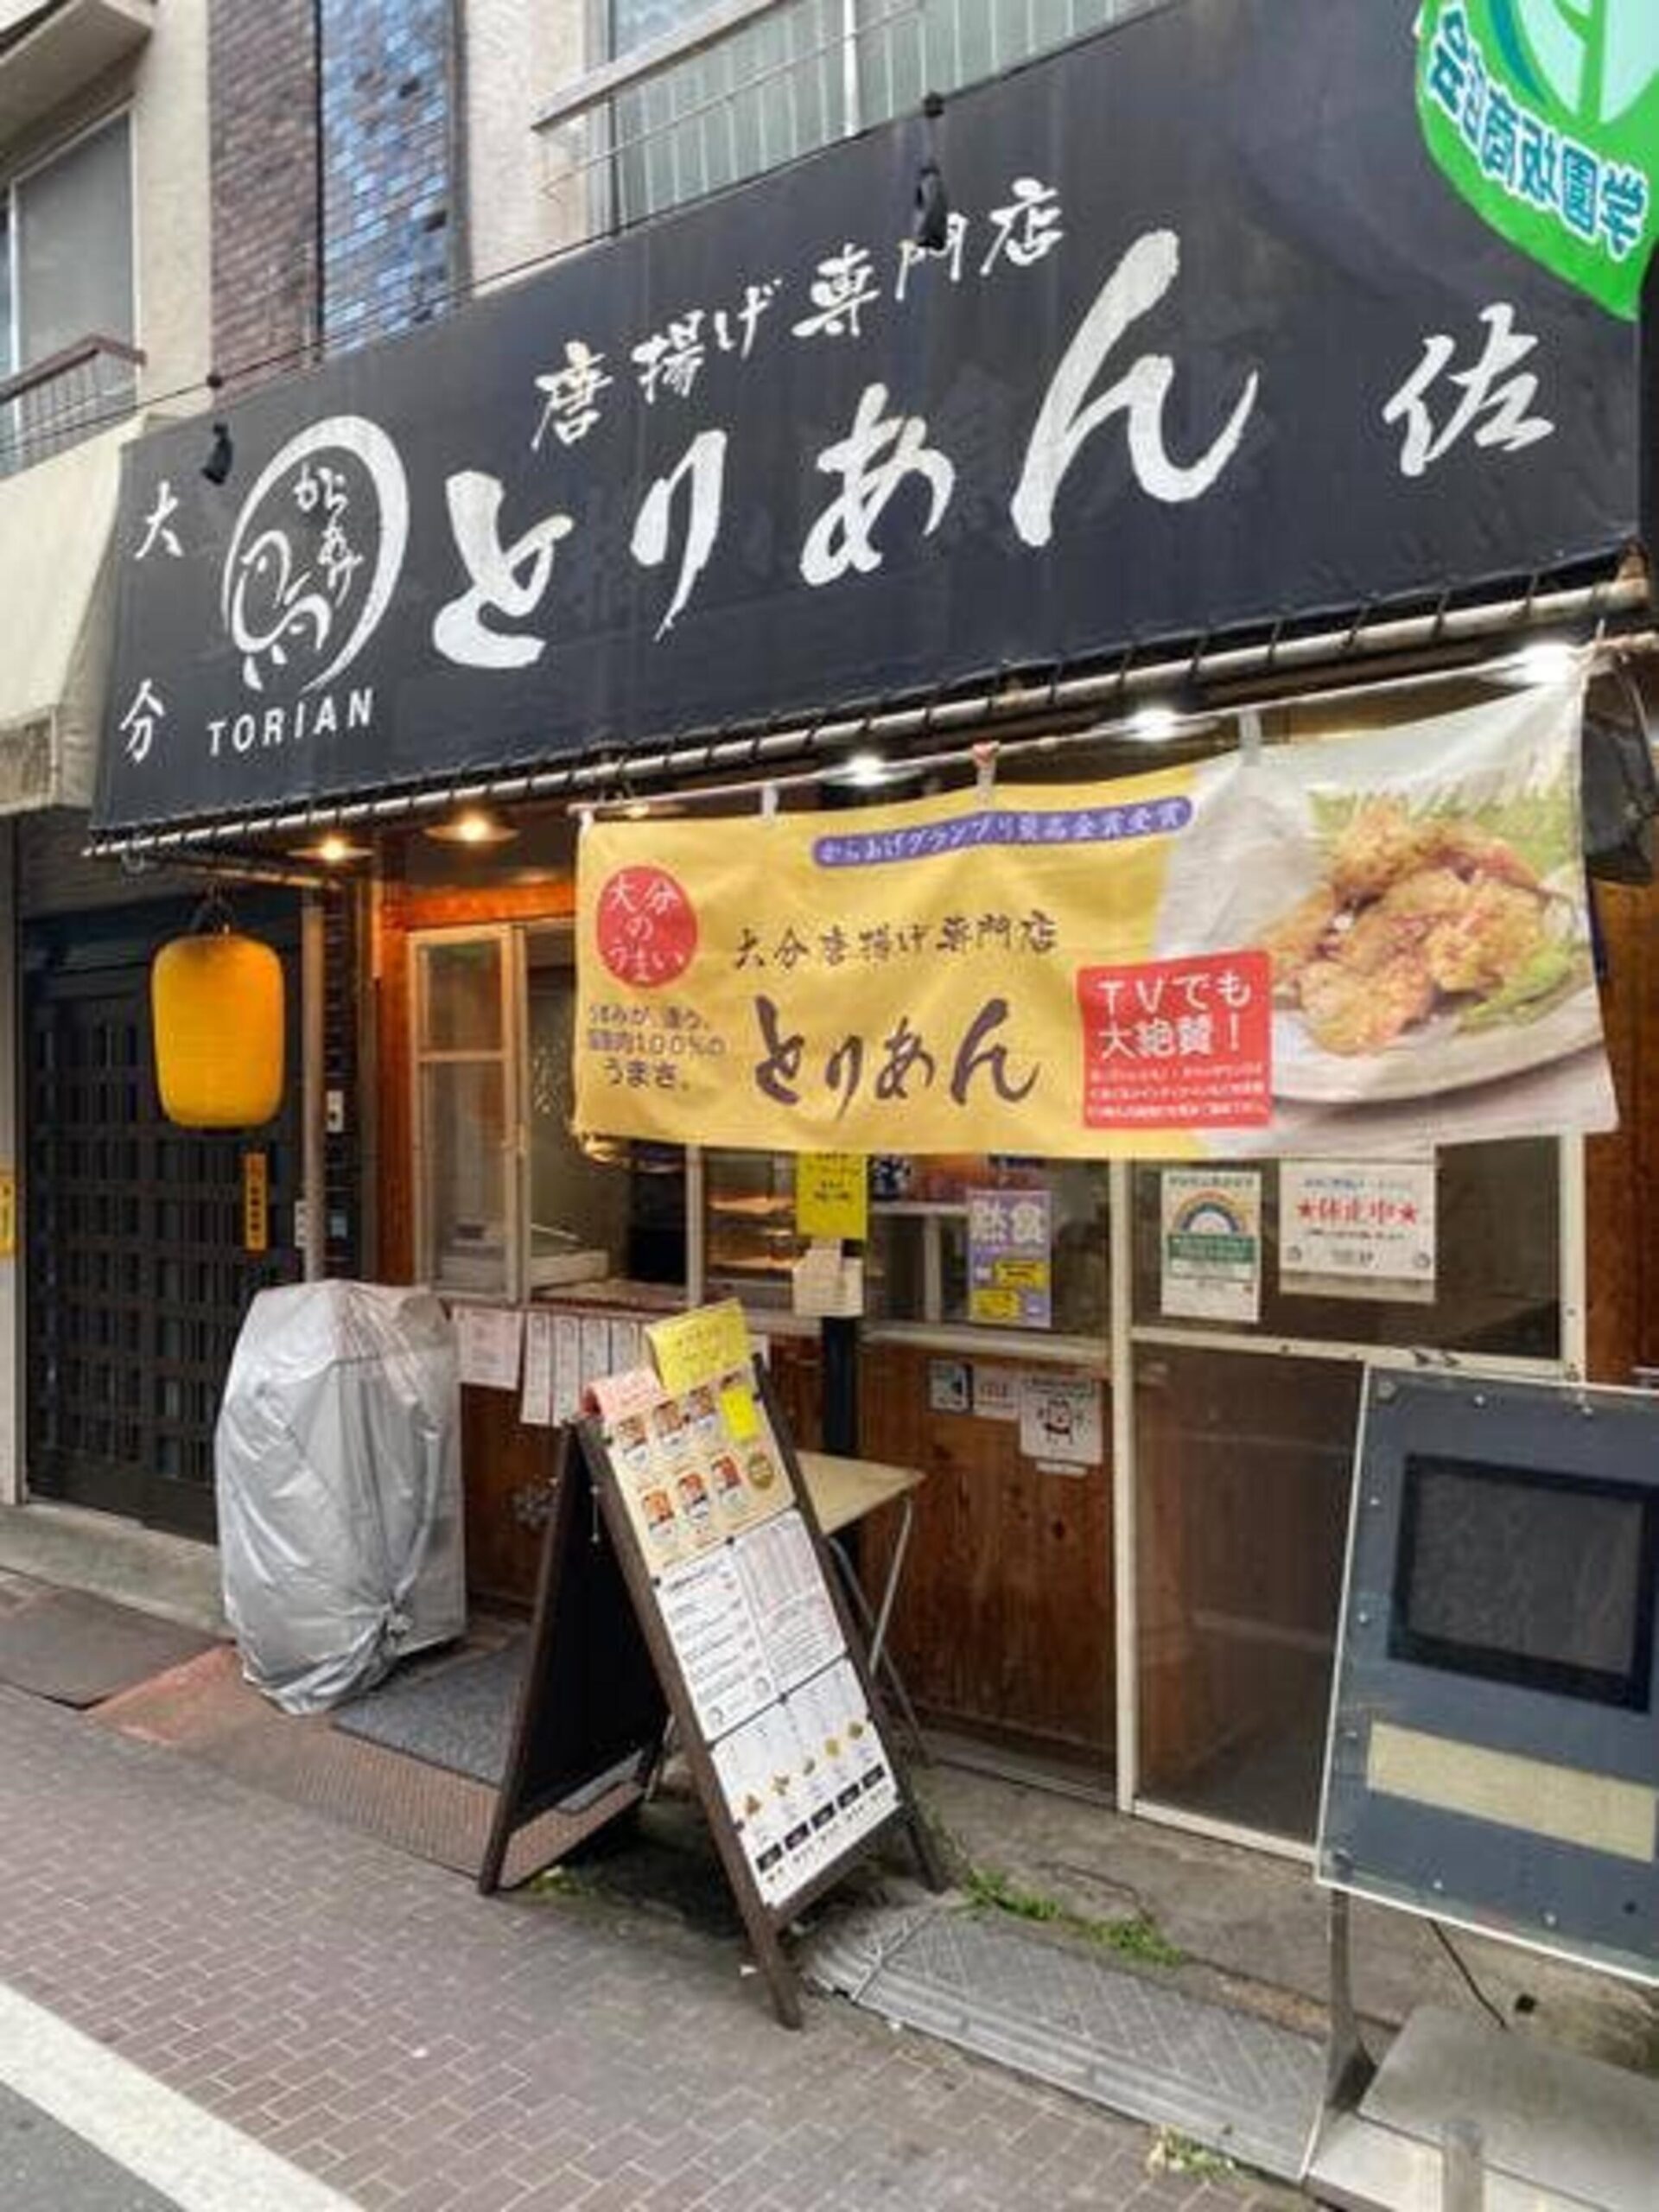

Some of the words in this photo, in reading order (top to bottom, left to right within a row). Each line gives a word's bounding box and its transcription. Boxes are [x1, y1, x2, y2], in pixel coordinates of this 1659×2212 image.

[531, 177, 1064, 452] 唐揚げ専門店
[1383, 302, 1555, 476] 佐
[432, 229, 1258, 669] とりあん
[207, 688, 373, 757] TORIAN
[610, 874, 681, 915] 大分
[624, 916, 655, 941] の
[734, 909, 1057, 969] 大分唐揚げ専門店
[1097, 969, 1252, 1015] TVでも
[754, 995, 1040, 1122] とりあん
